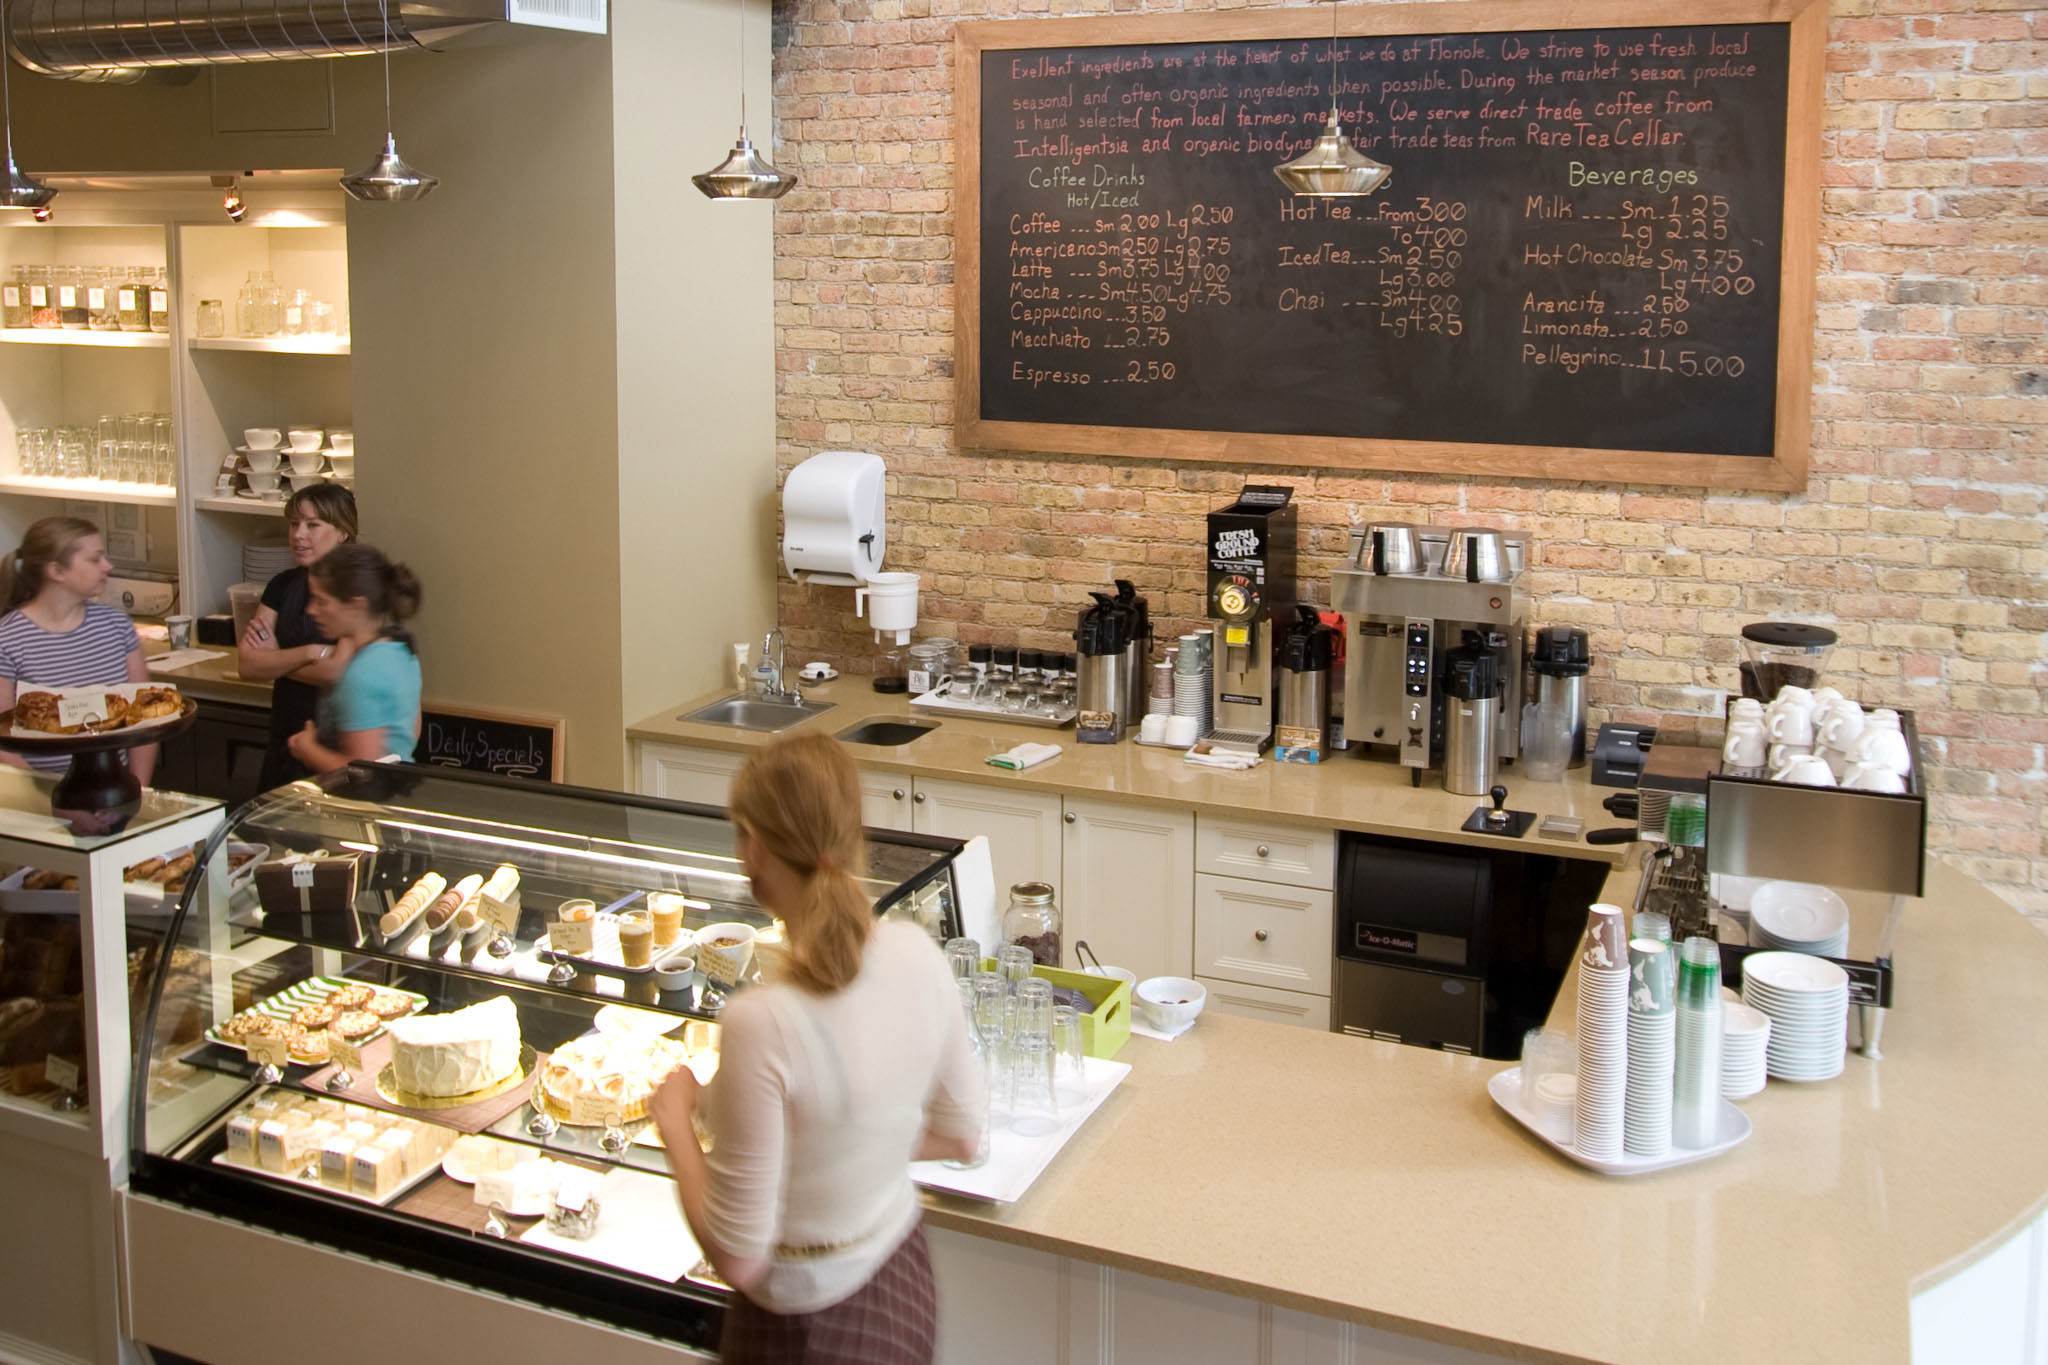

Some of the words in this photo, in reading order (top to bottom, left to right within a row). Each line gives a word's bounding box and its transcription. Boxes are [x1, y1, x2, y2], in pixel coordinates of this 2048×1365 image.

[1081, 50, 1153, 80] ingredients
[1164, 56, 1182, 68] are
[1193, 54, 1207, 68] at
[1215, 48, 1238, 66] the
[1244, 43, 1282, 65] heart
[1290, 43, 1309, 63] of
[1316, 44, 1352, 62] what
[1359, 49, 1376, 61] we
[1381, 42, 1396, 61] do
[1402, 41, 1421, 61] at
[1502, 37, 1530, 61] We
[1539, 35, 1584, 59] strive
[1593, 35, 1610, 58] to
[1618, 41, 1644, 57] use
[1649, 32, 1697, 57] fresh
[1709, 31, 1750, 56] local
[1012, 84, 1072, 110] seasonal
[1084, 85, 1111, 106] and
[1122, 83, 1162, 104] often
[1170, 83, 1229, 108] organic
[1238, 76, 1320, 104] ingredients
[1328, 77, 1371, 96] when
[1461, 69, 1516, 95] During
[1527, 64, 1554, 86] the
[1561, 59, 1620, 82] market
[1631, 64, 1686, 82] season
[1694, 58, 1757, 88] produce
[1016, 115, 1025, 130] is
[1034, 113, 1067, 130] hand
[1079, 106, 1143, 129] selected
[1151, 106, 1184, 129] from
[1192, 103, 1226, 127] local
[1237, 104, 1297, 127] farmers
[1303, 101, 1380, 124] makets.
[1389, 99, 1418, 122] We
[1426, 107, 1471, 120] serve
[1479, 99, 1528, 120] direct
[1536, 98, 1583, 121] trade
[1594, 91, 1653, 117] coffee
[1666, 90, 1713, 114] from
[1013, 133, 1129, 165] Intelligentsia
[1141, 131, 1171, 152] and
[1184, 138, 1241, 157] organic
[1351, 126, 1382, 149] fair
[1389, 124, 1437, 148] trade
[1443, 131, 1473, 149] teas
[1479, 126, 1516, 148] from
[1526, 122, 1572, 146] Rare
[1574, 122, 1610, 148] Tea
[1028, 166, 1086, 189] Coffee
[1093, 164, 1145, 188] Drinks
[1569, 161, 1698, 193] Beverages
[1280, 198, 1317, 222] Hot
[1321, 198, 1351, 220] Tea
[1525, 195, 1573, 218] Milk
[1621, 201, 1654, 219] Sm
[1010, 213, 1061, 235] Coffee
[1095, 220, 1115, 233] Sm
[1167, 210, 1189, 239] Lg
[1391, 226, 1412, 244] To
[1622, 222, 1652, 248] Lg
[1666, 219, 1727, 239] 2.25
[1010, 241, 1096, 258] Americano
[1096, 241, 1120, 256] Sm
[1164, 237, 1184, 265] Lg
[1278, 246, 1321, 267] Iced
[1324, 243, 1350, 264] Tea
[1378, 247, 1402, 264] Sm
[1524, 244, 1563, 265] Hot
[1567, 244, 1653, 268] Chocolate
[1658, 250, 1688, 272] Sm
[1012, 260, 1052, 278] Latte
[1098, 261, 1122, 278] Sm
[1165, 259, 1184, 285] Lg
[1380, 269, 1403, 294] Lg
[1661, 272, 1687, 297] Lg
[1010, 282, 1059, 300] Mocha
[1100, 283, 1126, 301] Sm
[1167, 286, 1188, 312] Lg
[1278, 288, 1325, 311] Chai
[1382, 290, 1407, 307] Sm
[1523, 290, 1605, 313] Arancita
[1011, 302, 1102, 326] Cappuccino
[1380, 312, 1407, 338] Lg
[1523, 315, 1609, 335] Limonata
[1011, 327, 1090, 349] Macchiato
[1523, 344, 1622, 374] Pellegrino
[1012, 361, 1090, 388] Espresso
[1219, 529, 1255, 542] FRESH
[1217, 547, 1257, 559] COFFEE
[428, 722, 474, 764] Daily
[475, 731, 544, 769] Specials
